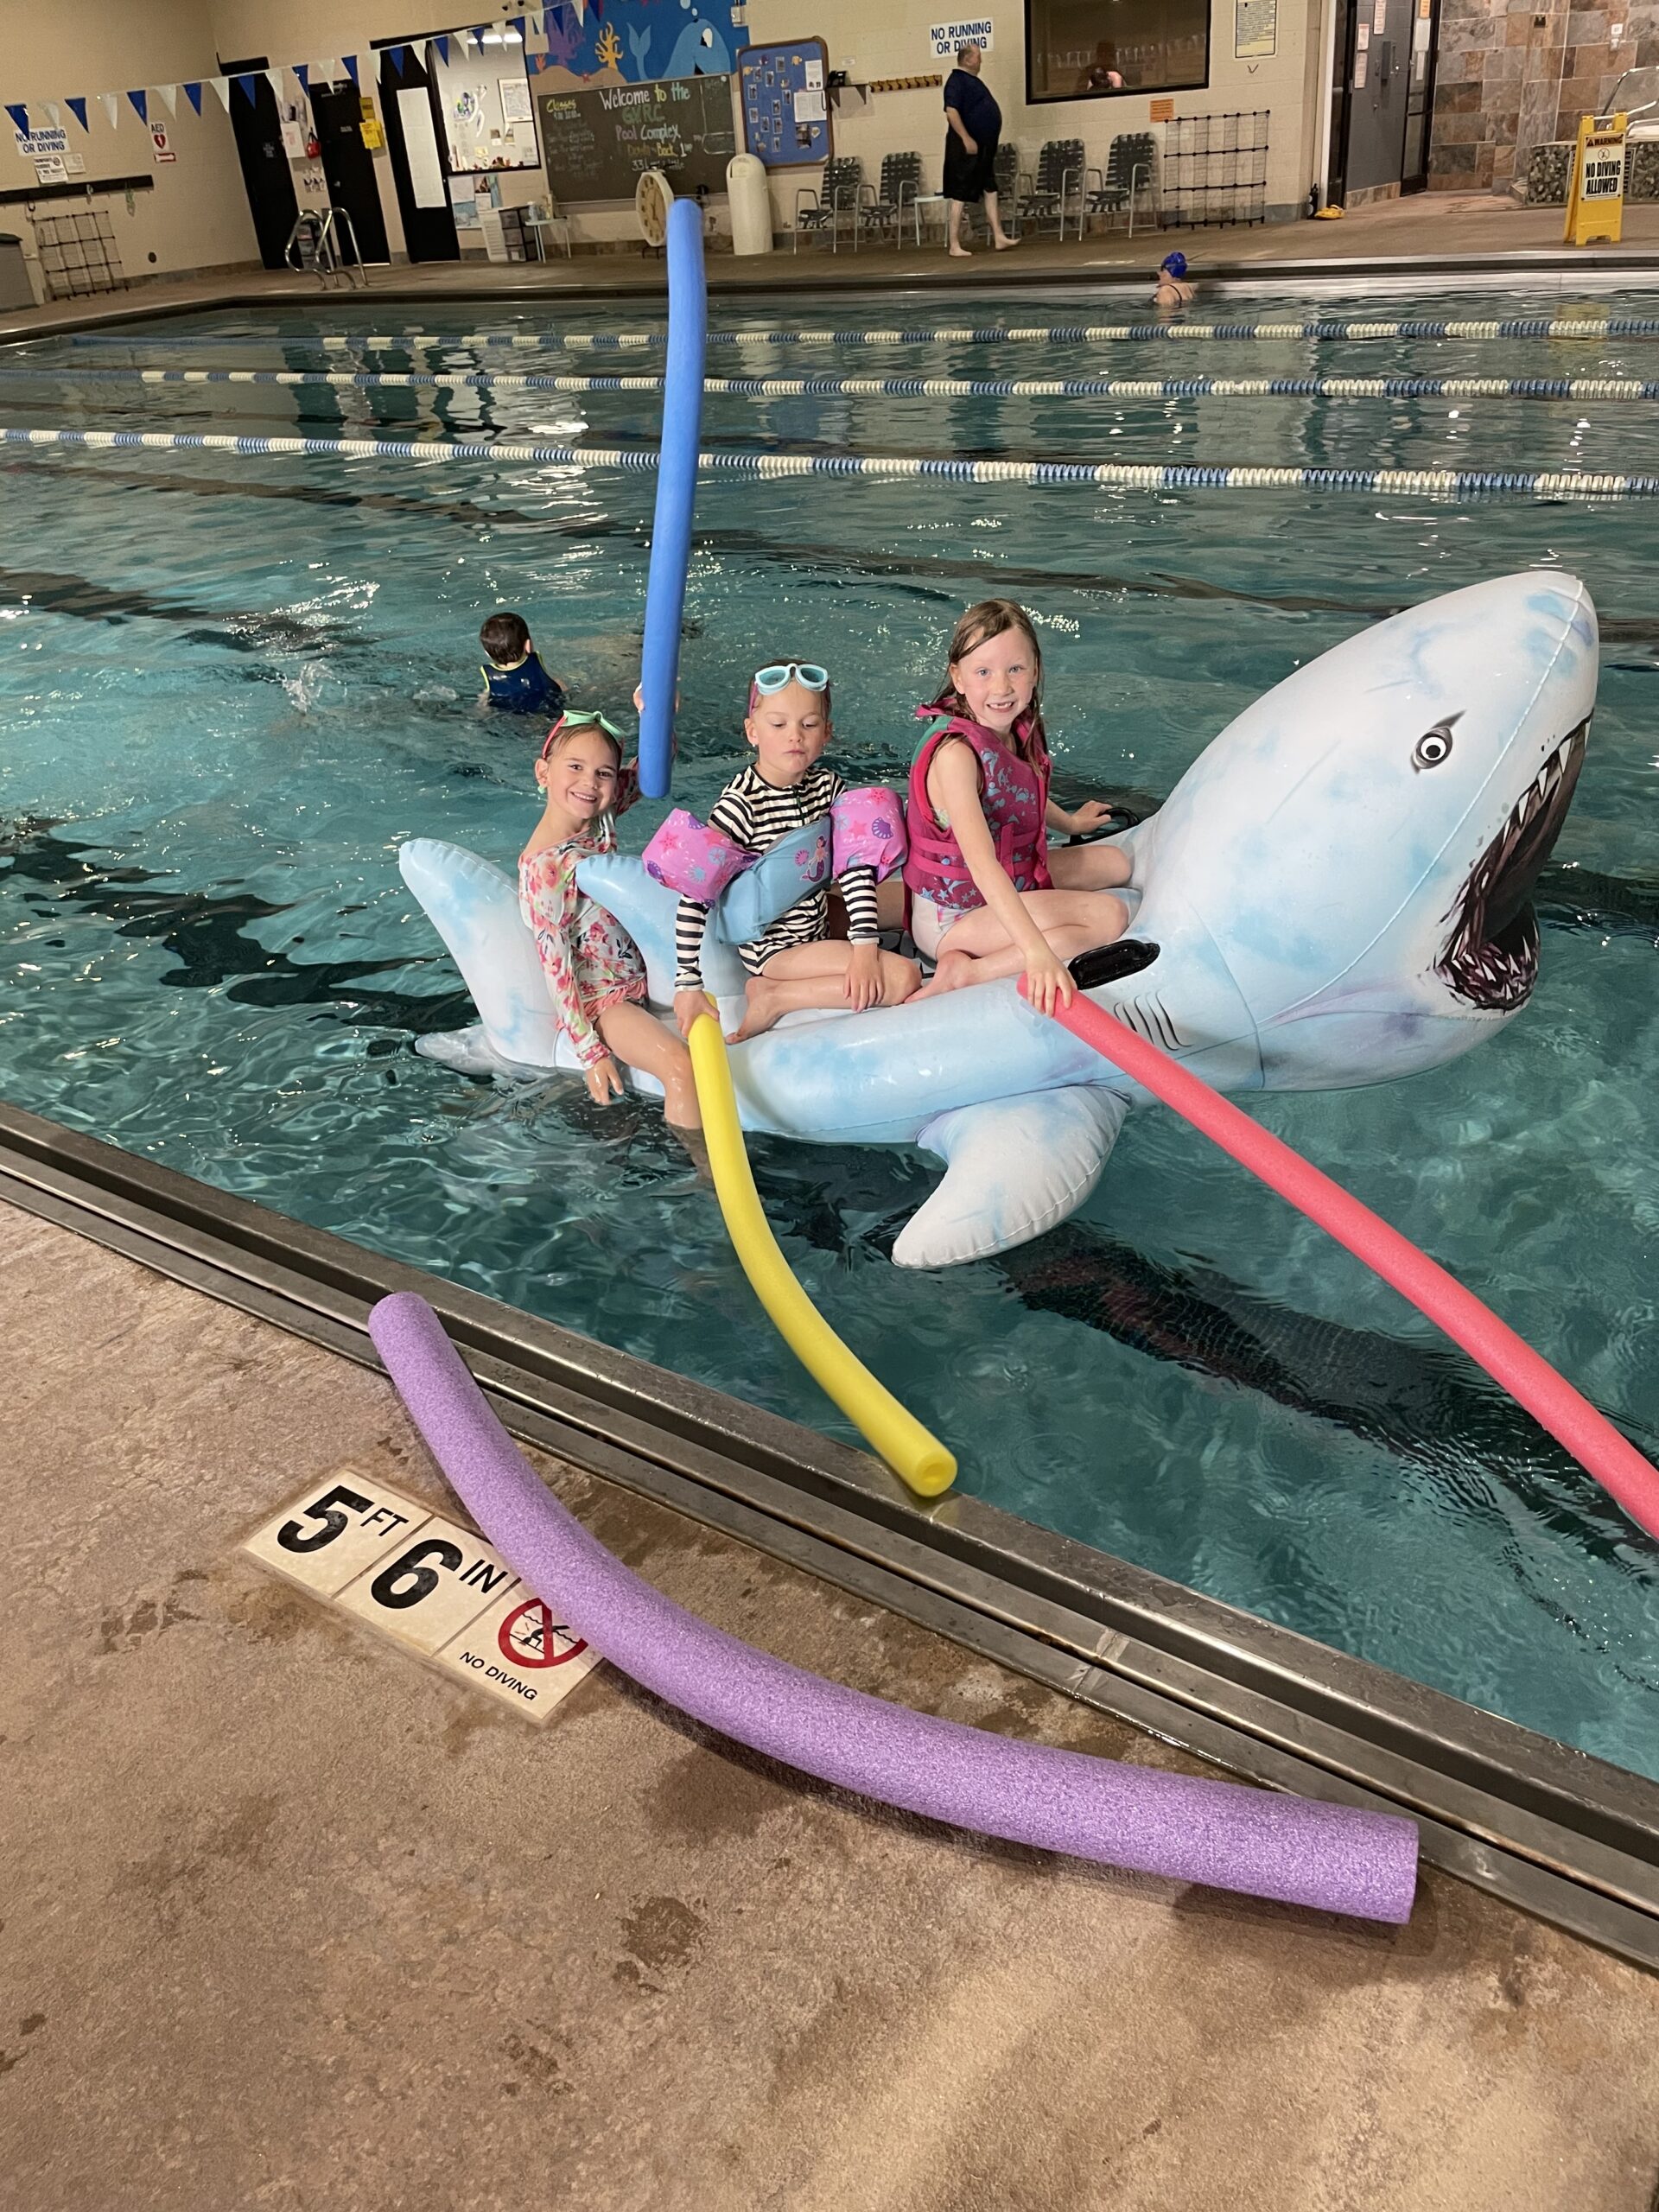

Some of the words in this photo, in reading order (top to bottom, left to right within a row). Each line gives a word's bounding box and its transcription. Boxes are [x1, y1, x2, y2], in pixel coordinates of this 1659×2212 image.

[931, 28, 944, 41] NO
[949, 22, 991, 38] RUNNING
[937, 41, 950, 54] OR
[599, 88, 650, 110] Welcome
[654, 84, 667, 102] to
[671, 82, 690, 101] the
[30, 130, 66, 142] RUNNING
[151, 124, 164, 133] AED
[615, 124, 638, 141] Pool
[640, 123, 682, 143] Complex
[22, 143, 35, 153] OR
[37, 141, 65, 152] DIVING
[1586, 162, 1596, 178] NO
[1597, 160, 1621, 177] DIVING
[1586, 177, 1618, 194] ALLOWED
[277, 1485, 375, 1554] 5
[360, 1507, 410, 1537] FT
[371, 1539, 463, 1609] 6
[459, 1559, 508, 1594] IN
[460, 1651, 485, 1669] NO
[485, 1666, 537, 1701] DIVING
